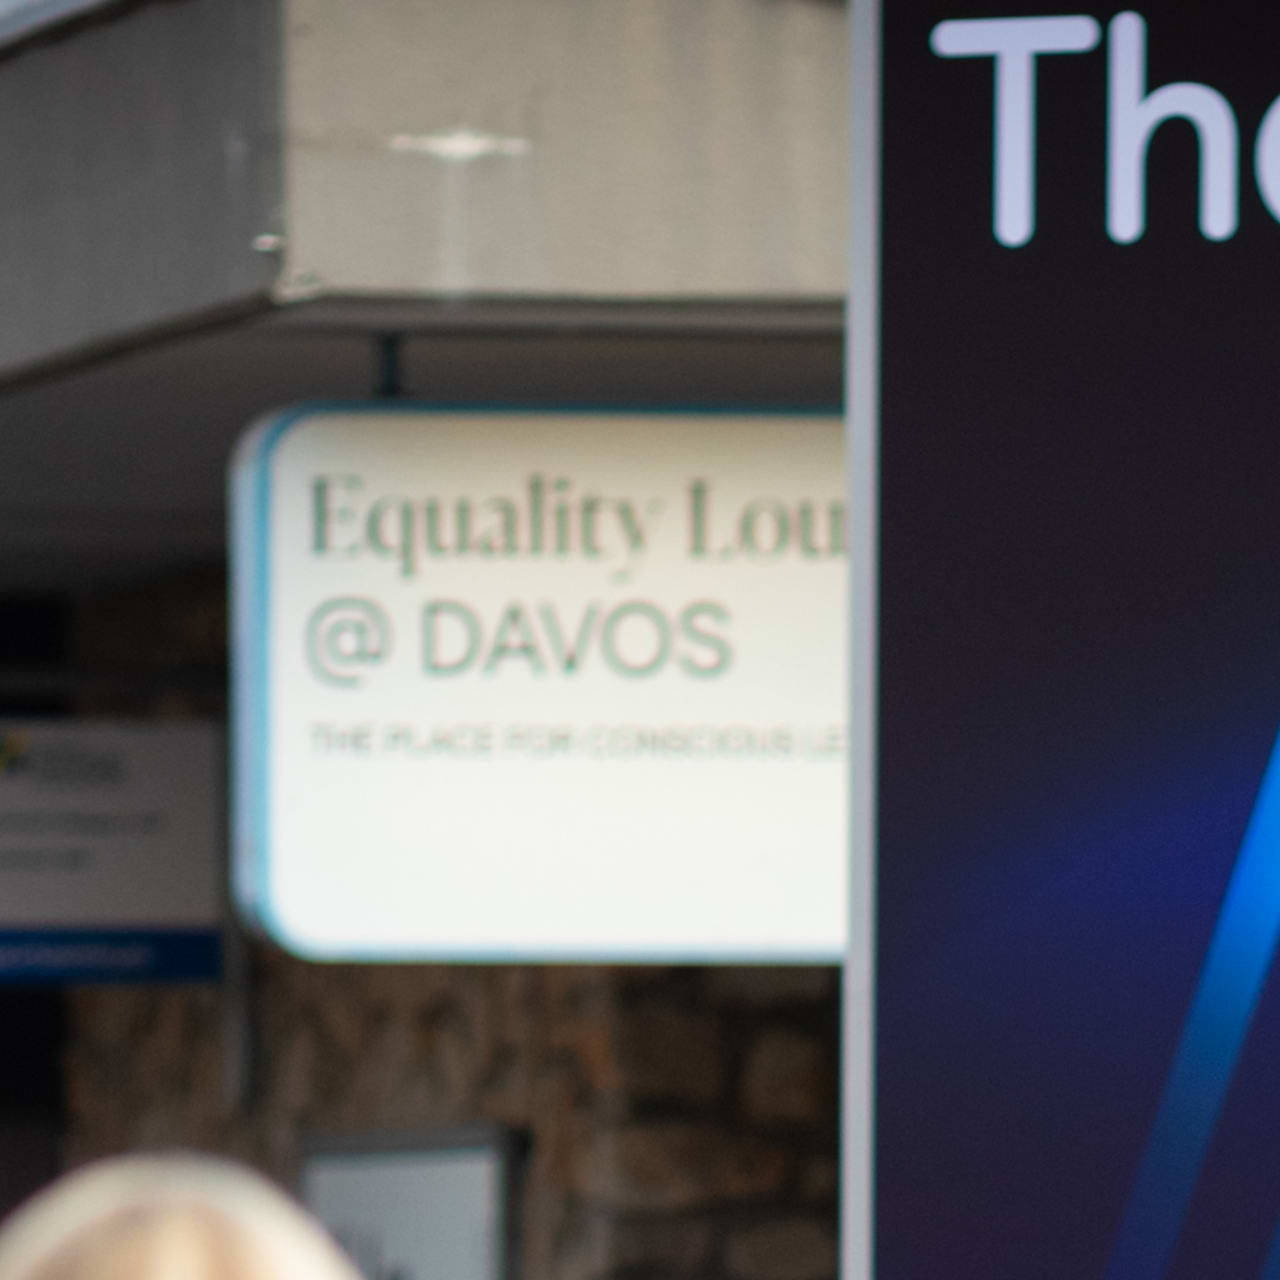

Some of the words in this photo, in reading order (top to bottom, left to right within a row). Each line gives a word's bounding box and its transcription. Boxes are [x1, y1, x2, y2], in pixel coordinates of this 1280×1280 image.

[308, 472, 663, 586] Equality
[305, 596, 394, 688] @
[421, 599, 735, 680] DAVOS
[310, 722, 374, 758] THE
[383, 722, 493, 758] PLACE
